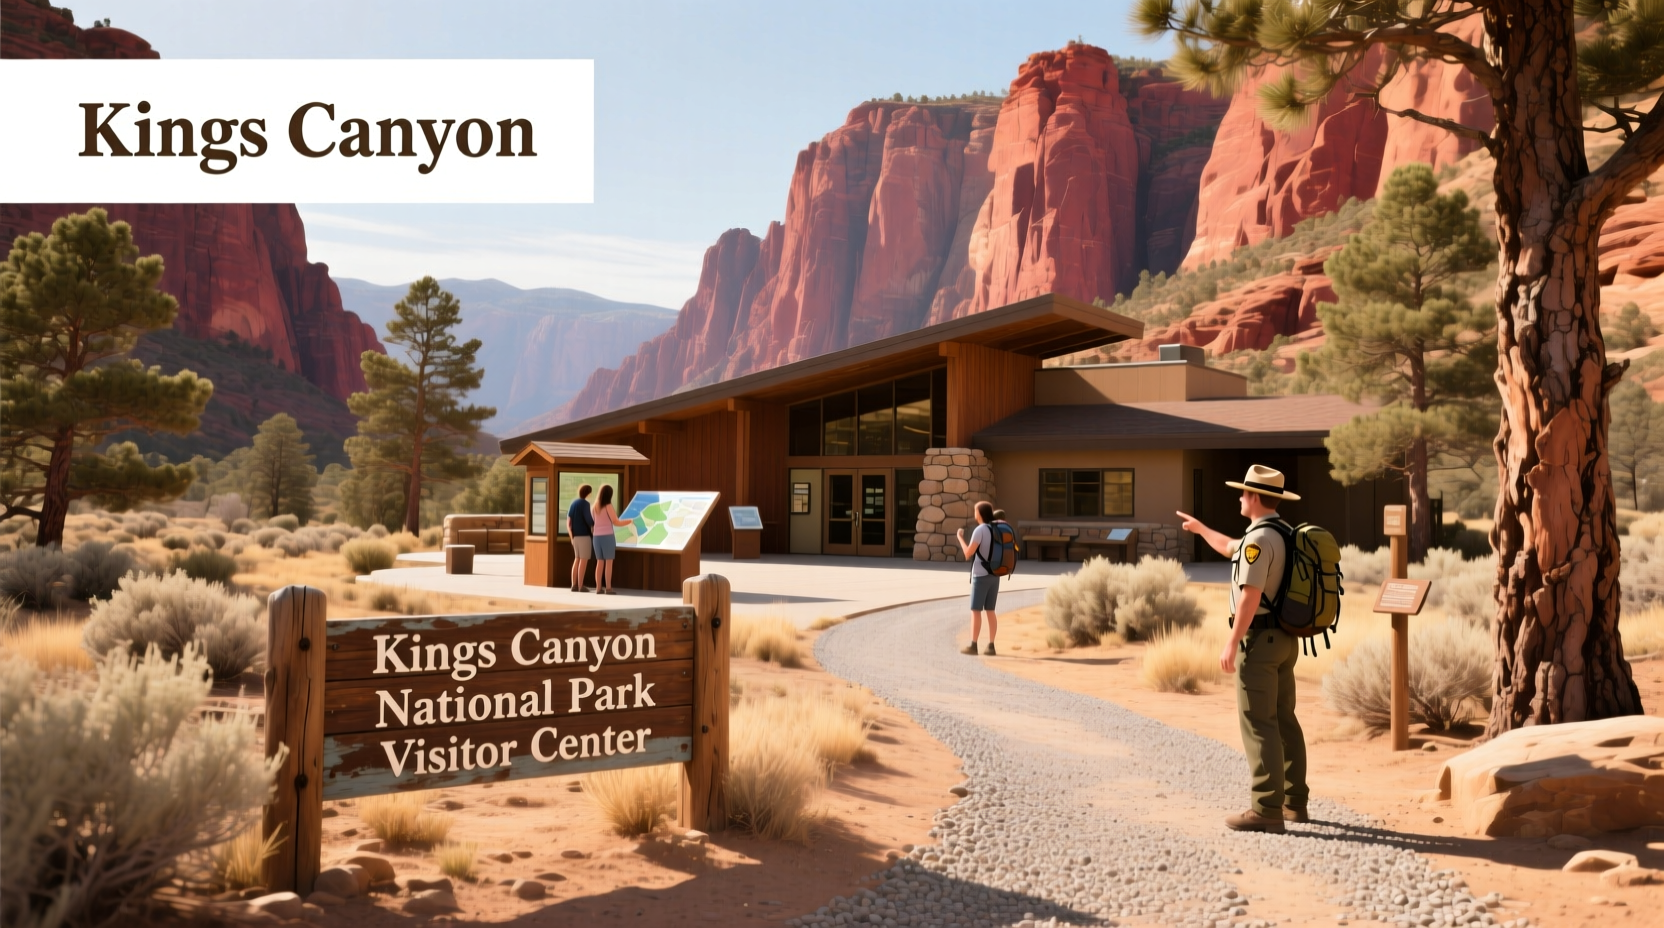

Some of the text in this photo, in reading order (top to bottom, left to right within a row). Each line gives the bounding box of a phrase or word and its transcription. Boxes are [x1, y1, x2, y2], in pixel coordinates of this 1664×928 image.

[373, 628, 657, 681] Kings Canyon
[375, 673, 656, 728] National Park
[380, 726, 652, 777] Visitor Center
